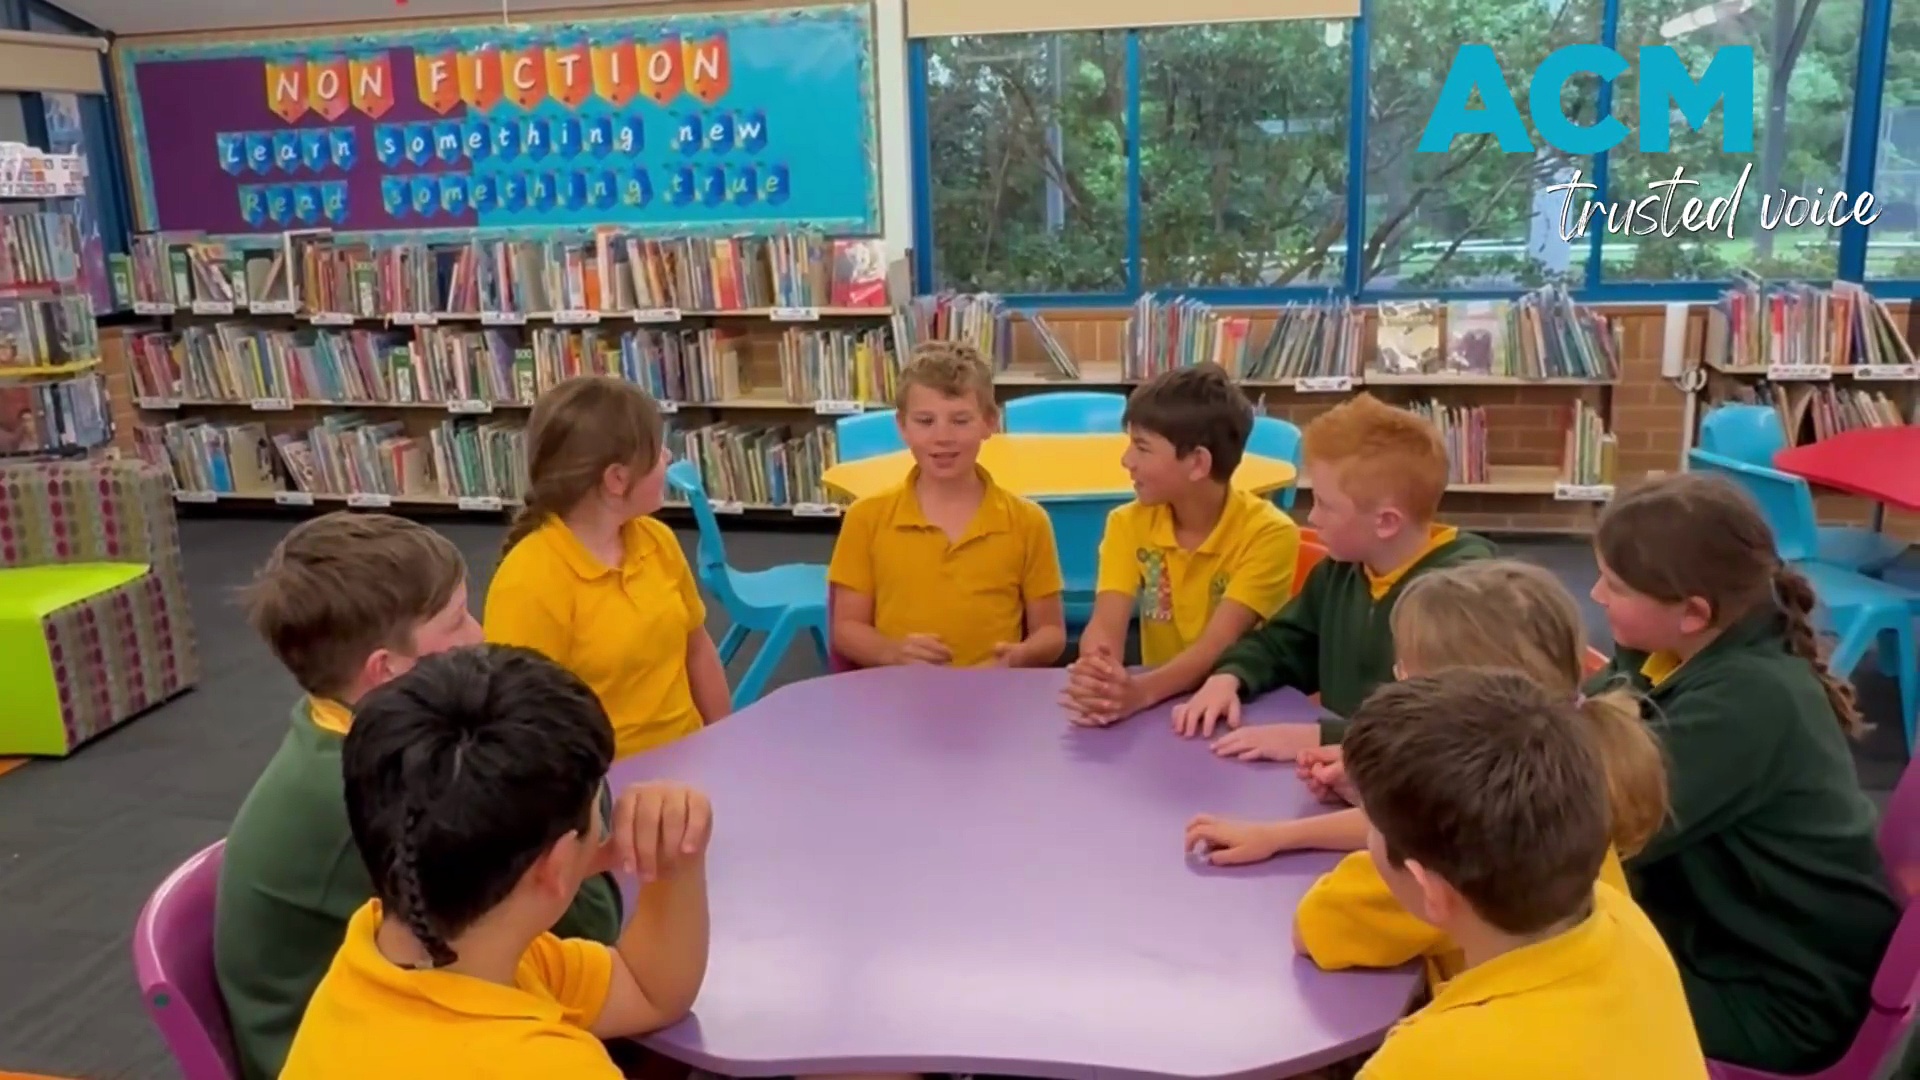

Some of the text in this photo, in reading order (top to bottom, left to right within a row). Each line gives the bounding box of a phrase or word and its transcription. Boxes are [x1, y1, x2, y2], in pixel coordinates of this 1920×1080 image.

[276, 46, 720, 102] NON FICTION
[226, 121, 762, 163] Learn something new
[246, 172, 780, 213] Read something true
